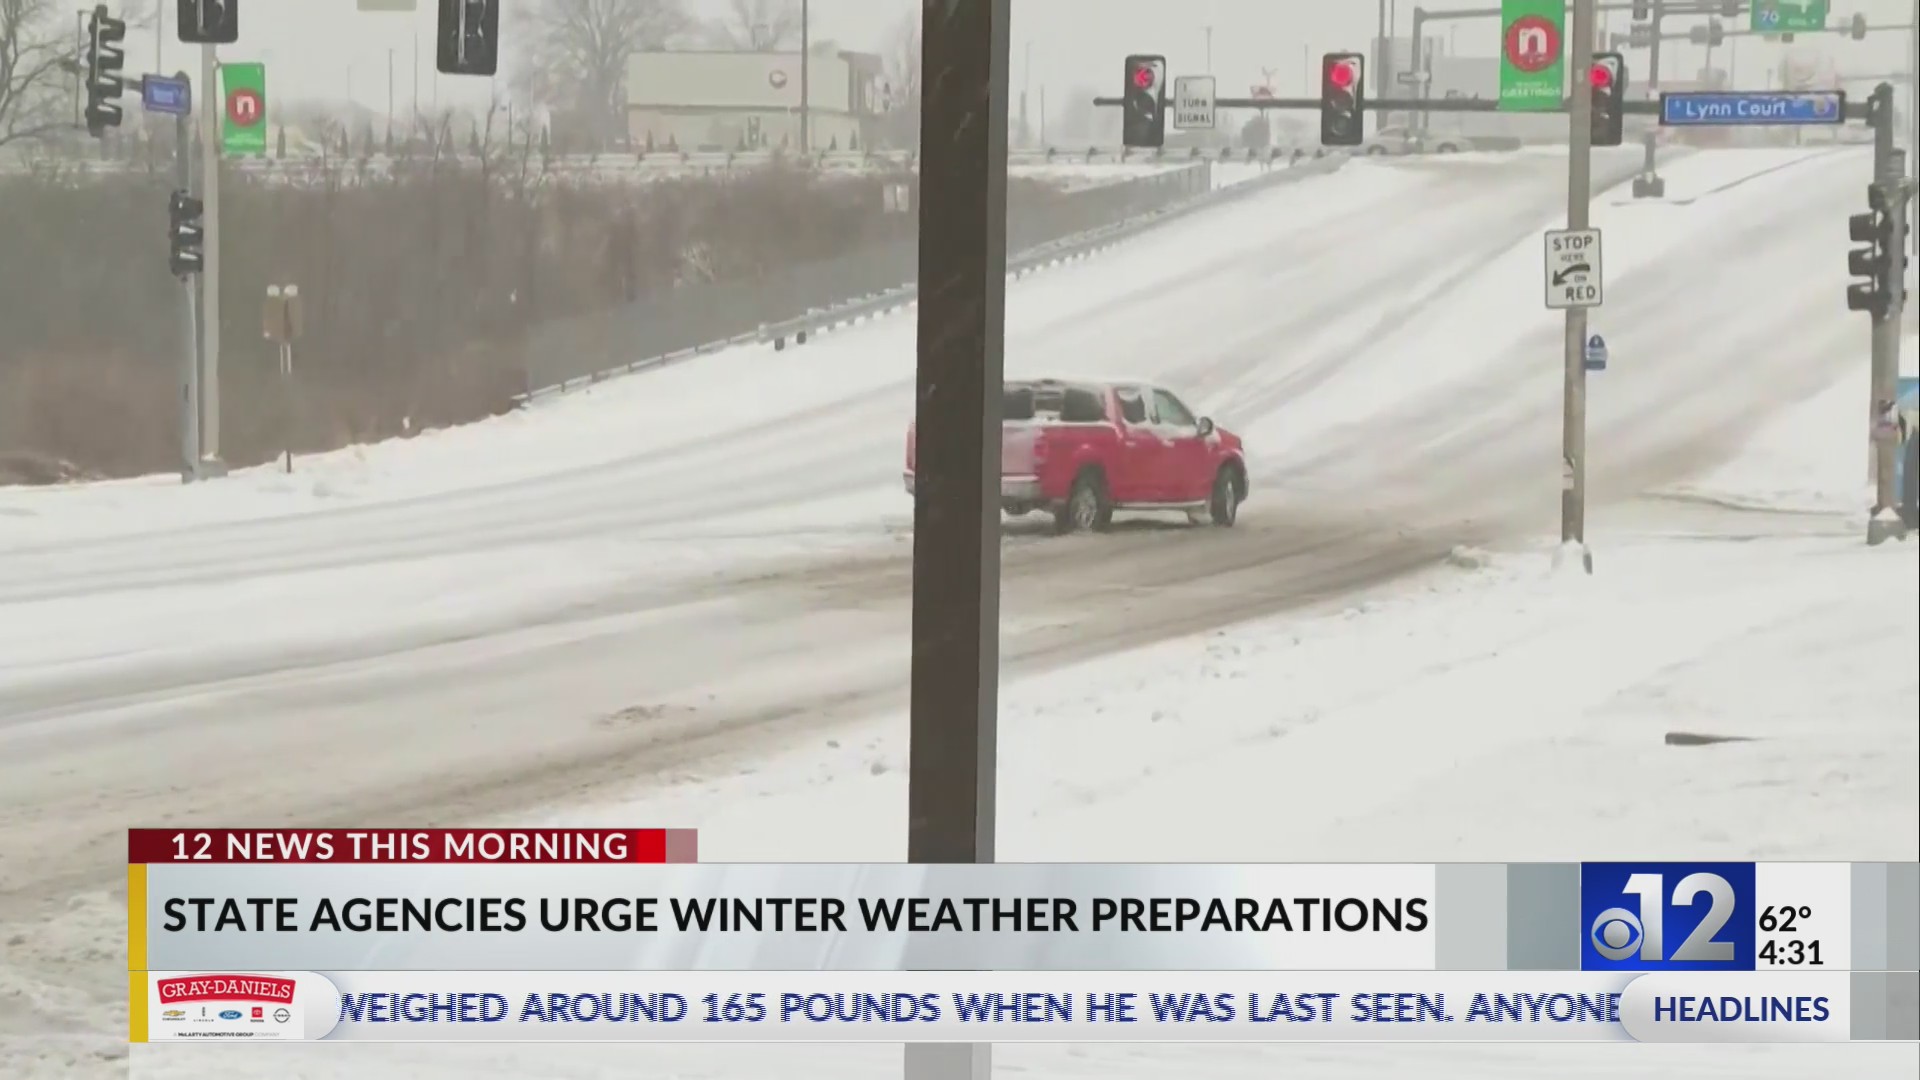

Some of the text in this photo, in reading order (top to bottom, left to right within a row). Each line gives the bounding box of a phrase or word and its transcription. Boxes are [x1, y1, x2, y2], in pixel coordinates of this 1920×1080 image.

[1519, 27, 1547, 55] n
[236, 95, 255, 115] n
[1686, 101, 1731, 119] Lynn
[1737, 100, 1786, 116] Court
[1553, 235, 1593, 251] STOP
[1565, 285, 1596, 301] RED
